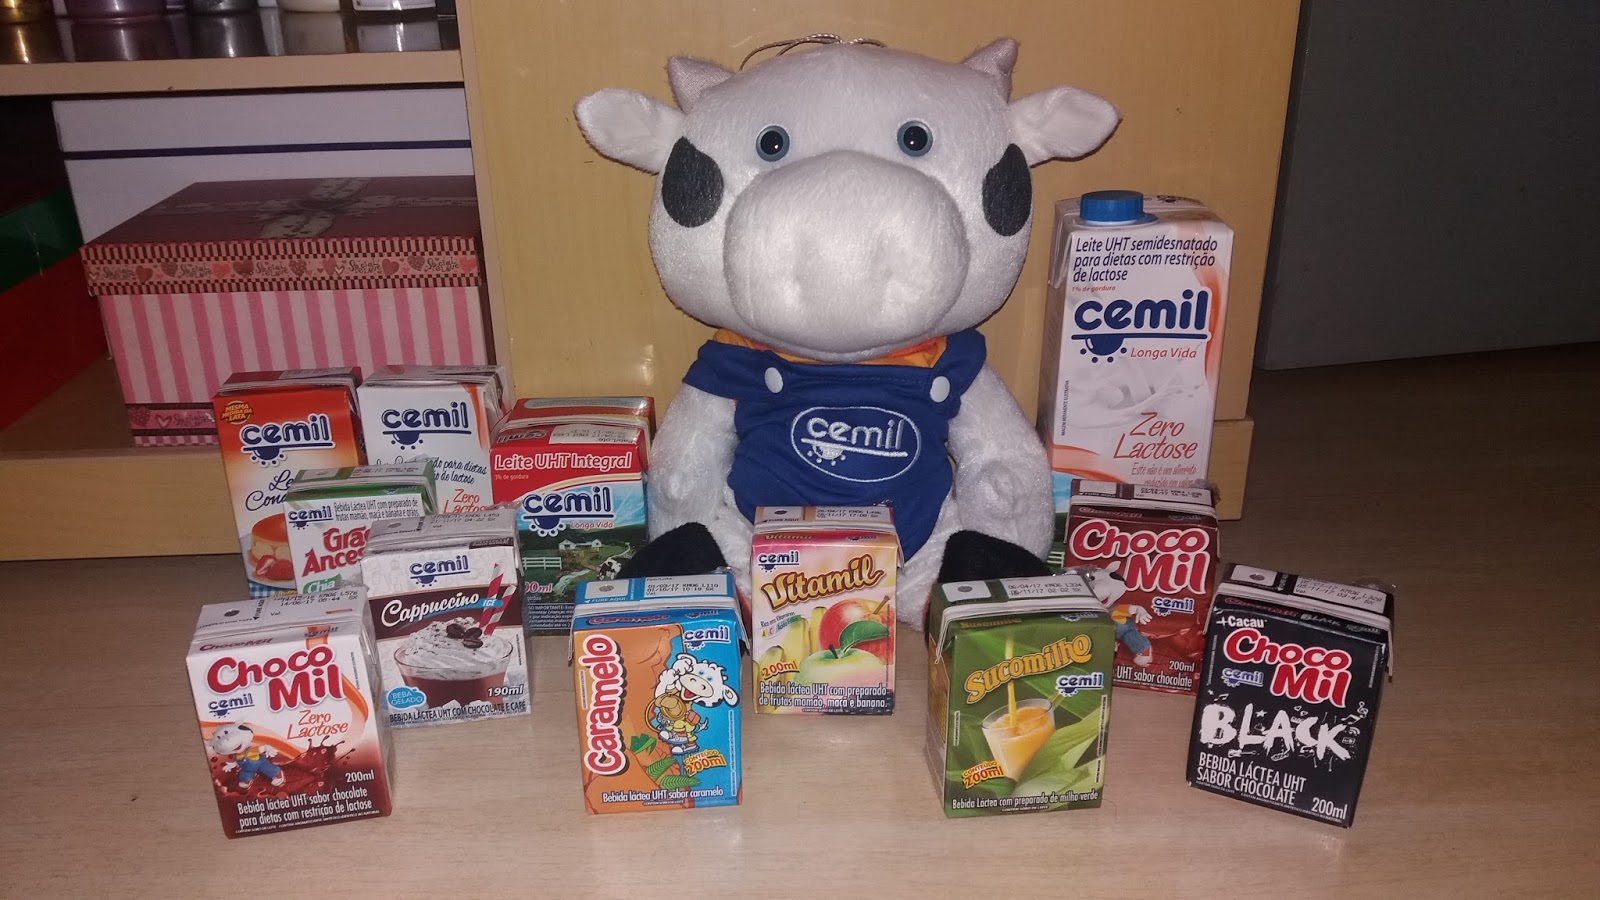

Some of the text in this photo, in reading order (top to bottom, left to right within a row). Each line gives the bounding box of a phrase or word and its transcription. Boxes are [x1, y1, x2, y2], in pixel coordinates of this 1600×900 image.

[1076, 235, 1218, 252] Leite UHT semidesnatado
[1074, 252, 1215, 271] para dietas com restrição
[1074, 268, 1128, 282] de lactose
[1074, 289, 1209, 331] cemil
[1131, 347, 1197, 360] Longa Vida
[226, 404, 249, 412] MESMA
[381, 401, 469, 429] cemil
[241, 415, 330, 445] cemil
[807, 417, 904, 449] cemil
[1130, 412, 1185, 436] Zero
[1113, 433, 1198, 459] Lactose
[443, 460, 462, 470] para
[464, 461, 488, 475] dietas
[495, 452, 632, 472] Leite UHT Integral
[1131, 462, 1146, 475] Este
[441, 471, 450, 481] de
[451, 472, 475, 484] lactose
[454, 488, 480, 503] Zero
[523, 486, 611, 513] cemil
[288, 506, 332, 520] cemil
[443, 500, 487, 514] Lactos
[571, 521, 614, 530] Longa Vida
[1071, 521, 1206, 558] Choco
[410, 555, 469, 575] cemil
[759, 551, 799, 563] cemil
[762, 554, 884, 610] Vitamil
[1127, 553, 1207, 593] Mil
[308, 579, 336, 594] Chia
[381, 592, 480, 627] Cappuccino
[483, 599, 496, 607] ICE
[1153, 598, 1193, 610] cemil
[684, 626, 729, 641] cemil
[1225, 629, 1350, 669] Choco
[208, 646, 333, 694] Choco
[762, 660, 798, 676] 200ml
[965, 634, 1092, 704] Sucomilho
[1169, 660, 1195, 672] 200ml
[1058, 674, 1103, 687] cemil
[1117, 665, 1133, 679] UHT
[1134, 668, 1156, 682] sabor
[1156, 670, 1192, 687] chocolate
[1222, 668, 1264, 683] cemil
[268, 664, 343, 711] Mil
[487, 685, 524, 698] 190ml
[760, 682, 887, 698] Bebida láctea UHT com preparado
[1272, 664, 1350, 706] Mil
[208, 693, 253, 710] cemil
[391, 695, 423, 706] GELADO
[393, 691, 412, 699] BEBA
[759, 695, 888, 709] de frutas mamão, maçã e banana.
[390, 713, 412, 722] BEBIDA
[414, 709, 437, 719] LÁCTEA
[438, 708, 451, 718] UHT
[452, 706, 467, 716] COM
[468, 703, 505, 714] CHOCOLATE
[510, 700, 526, 711] CAFÉ
[583, 637, 622, 772] Caramelo
[298, 710, 331, 725] Zero
[287, 722, 348, 740] Lactose
[1200, 704, 1350, 760] BLACK
[684, 750, 718, 764] CONTEÚDO
[686, 757, 725, 775] 200ml
[345, 769, 374, 783] 200ml
[963, 761, 997, 776] CONTEÚDO
[965, 766, 1003, 787] 200ml
[1199, 752, 1307, 793] BEBIDA LÁCTEA UHT
[603, 787, 724, 803] Bebida láctea UHT sabor caramelo
[1197, 766, 1231, 789] SABOR
[1234, 776, 1297, 806] CHOCOLATE
[237, 787, 368, 815] Bebida láctea UHT sabor chocolate
[952, 799, 975, 809] Bebida
[976, 798, 998, 807] Láctea
[1014, 792, 1049, 806] preparado
[1050, 791, 1059, 802] de
[1059, 791, 1079, 802] milho
[1080, 788, 1098, 800] verde
[239, 817, 258, 829] para
[260, 812, 282, 824] dietas
[284, 810, 300, 820] com
[301, 804, 334, 819] restrição
[335, 801, 345, 812] de
[346, 799, 372, 811] lactose
[1312, 797, 1348, 819] 200ml
